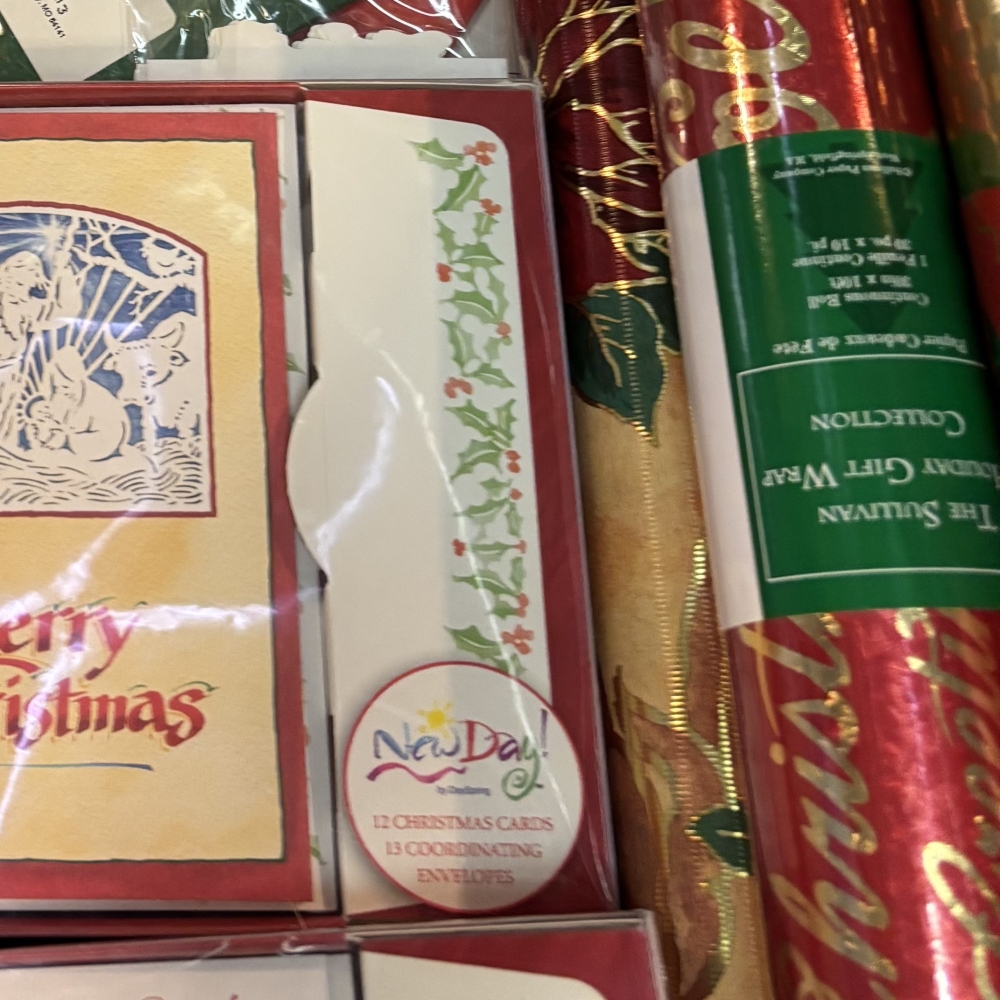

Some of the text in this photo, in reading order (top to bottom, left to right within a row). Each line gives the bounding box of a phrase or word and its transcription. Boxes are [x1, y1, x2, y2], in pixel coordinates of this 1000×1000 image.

[40, 3, 53, 18] MO
[56, 4, 69, 16] 3
[830, 239, 851, 251] 10
[855, 238, 867, 247] x
[865, 275, 877, 285] x
[807, 292, 931, 309] Continuous Roll
[817, 336, 840, 352] de
[844, 333, 921, 350] Cadeaux
[373, 815, 554, 832] 12 CHRISTMAS CARDS
[404, 841, 543, 858] COORDINATING
[416, 868, 515, 885] ENVELOPES
